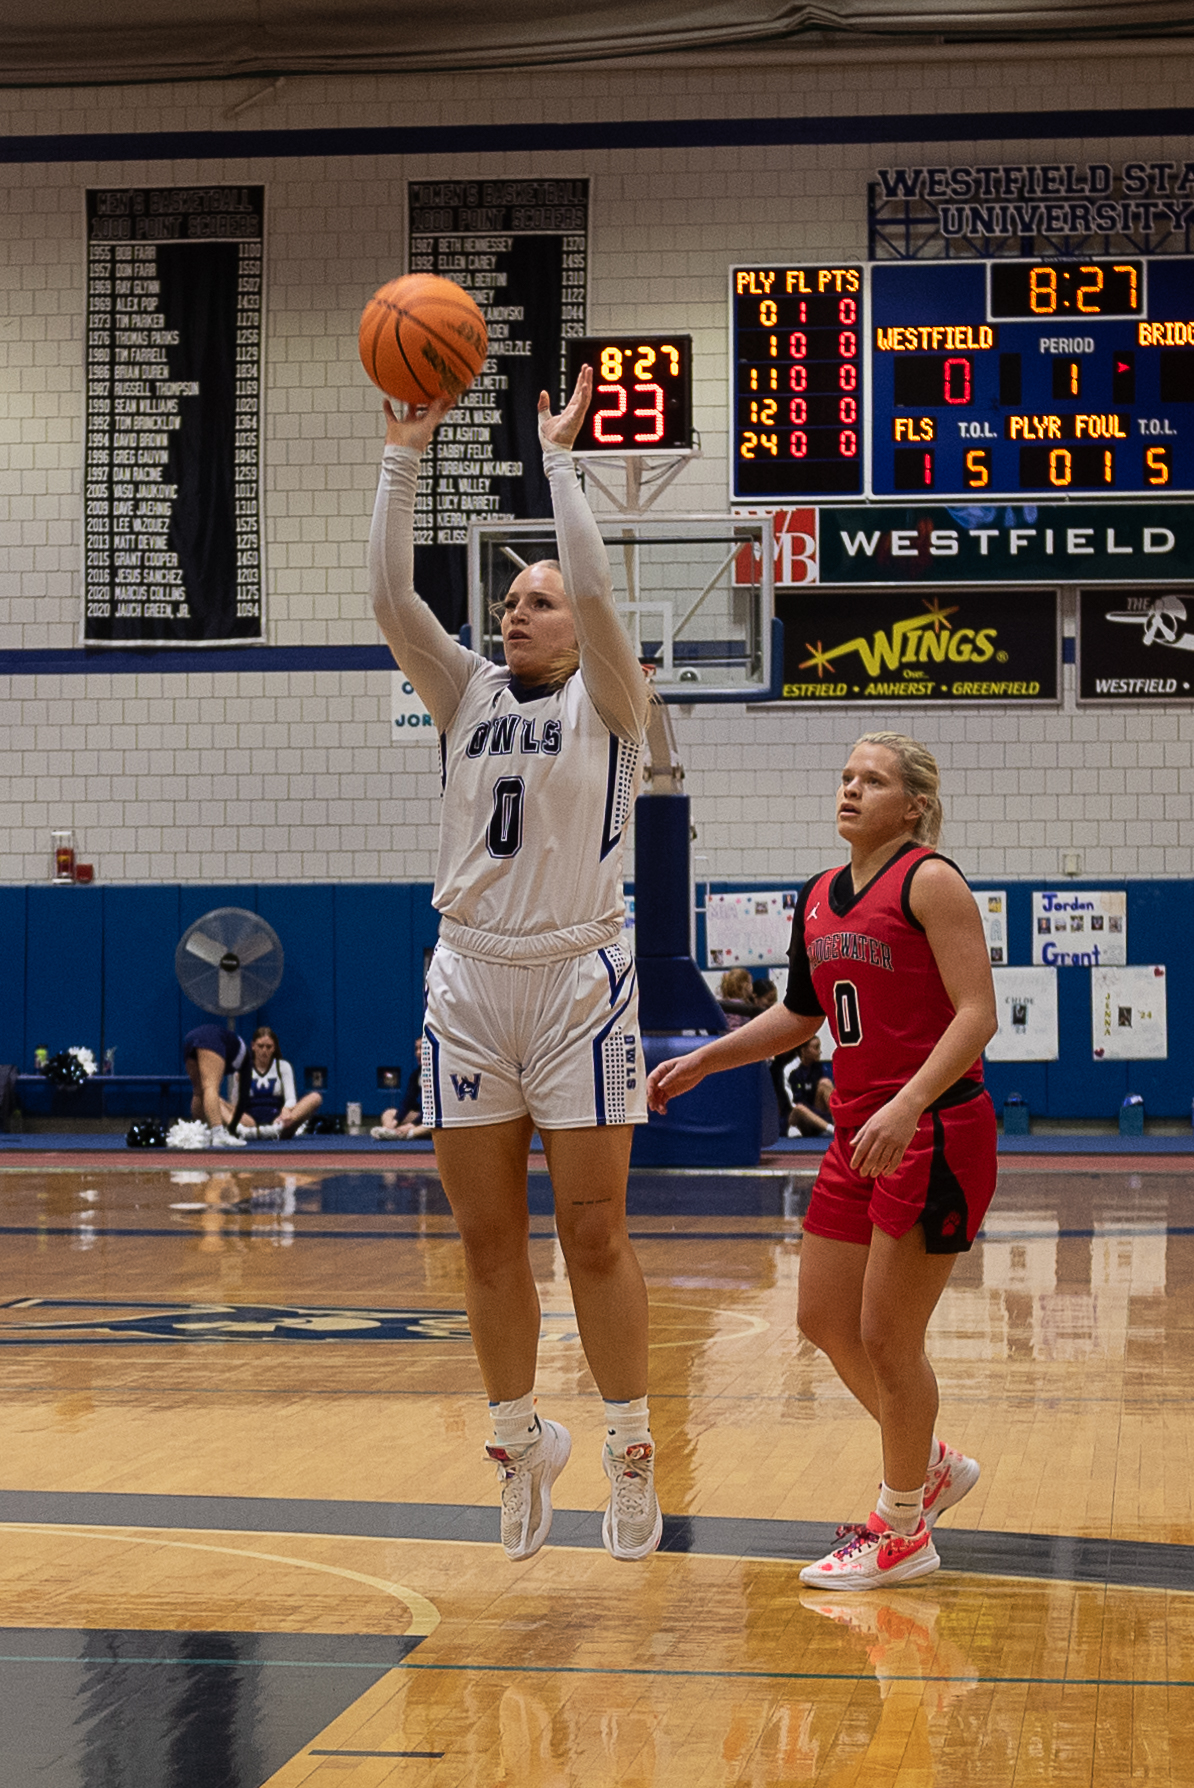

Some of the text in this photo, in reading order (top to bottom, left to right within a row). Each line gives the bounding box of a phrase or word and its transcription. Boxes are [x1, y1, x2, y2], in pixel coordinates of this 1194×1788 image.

[877, 161, 1194, 199] WESTFIELD STA
[938, 200, 1194, 237] UNIVERSITY
[737, 269, 859, 294] PLY FL PTS
[1029, 265, 1137, 313] 8:27
[759, 298, 856, 326] 0 1 0
[769, 331, 856, 358] 1 0 0
[877, 325, 993, 350] WESTFIELD
[1040, 337, 1095, 354] PERIOD
[750, 364, 856, 392] 11 0 0
[944, 357, 971, 404] 0
[1070, 363, 1078, 395] 1
[593, 383, 664, 443] 23
[750, 397, 856, 425] 12 0 0
[894, 417, 933, 441] FLS
[958, 421, 997, 438] T.O.L.
[1009, 414, 1126, 440] PLYR FOUL
[1138, 418, 1177, 436] T.O.L.
[740, 430, 857, 459] 24 0 0
[924, 453, 931, 485] 1
[966, 450, 989, 487] 5
[1146, 447, 1169, 485] 5
[113, 518, 130, 532] LEE
[840, 527, 1176, 558] WESTFIELD
[1127, 597, 1152, 610] THE
[822, 614, 998, 677] WINGS
[782, 681, 1040, 697] ESTFIELD AMHERST GREENFIELD
[1095, 679, 1177, 694] WESTFIELD
[395, 714, 434, 727] JOR
[466, 714, 562, 759] OWLS
[486, 776, 525, 859] 0
[1042, 942, 1101, 966] Grant
[833, 979, 863, 1048] 0
[623, 1034, 636, 1091] OWLS
